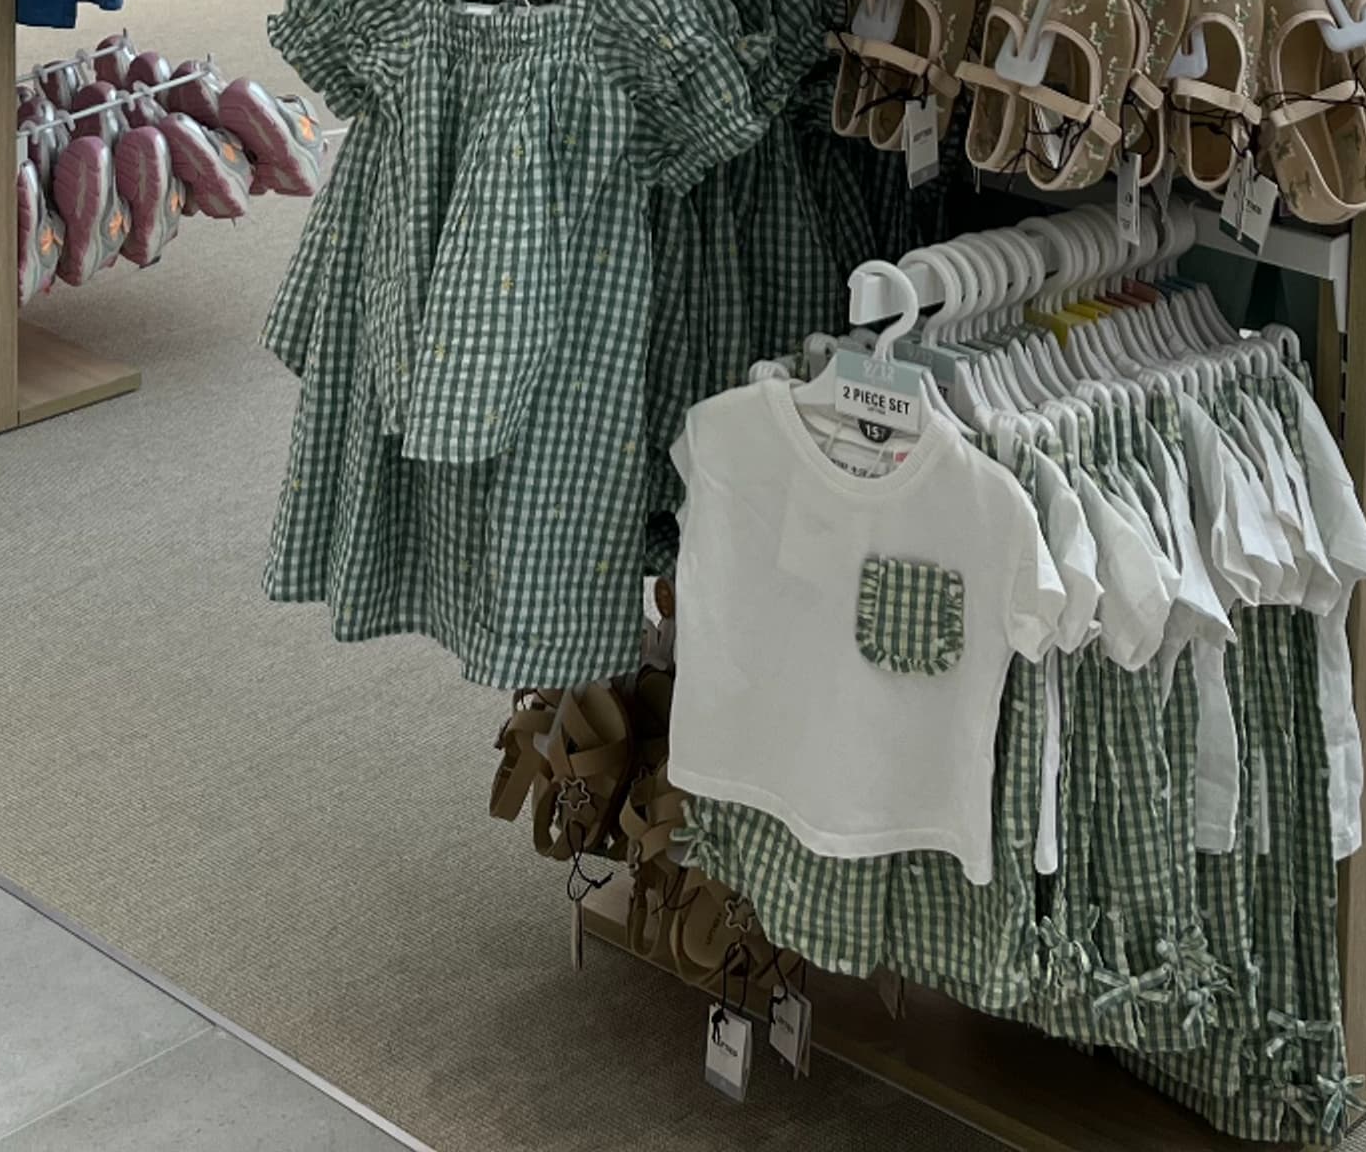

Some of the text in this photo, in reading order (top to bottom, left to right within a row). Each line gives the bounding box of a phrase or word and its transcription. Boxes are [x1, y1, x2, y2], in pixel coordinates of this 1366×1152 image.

[842, 385, 851, 399] 2
[853, 388, 887, 408] PIECE
[888, 397, 911, 415] SET
